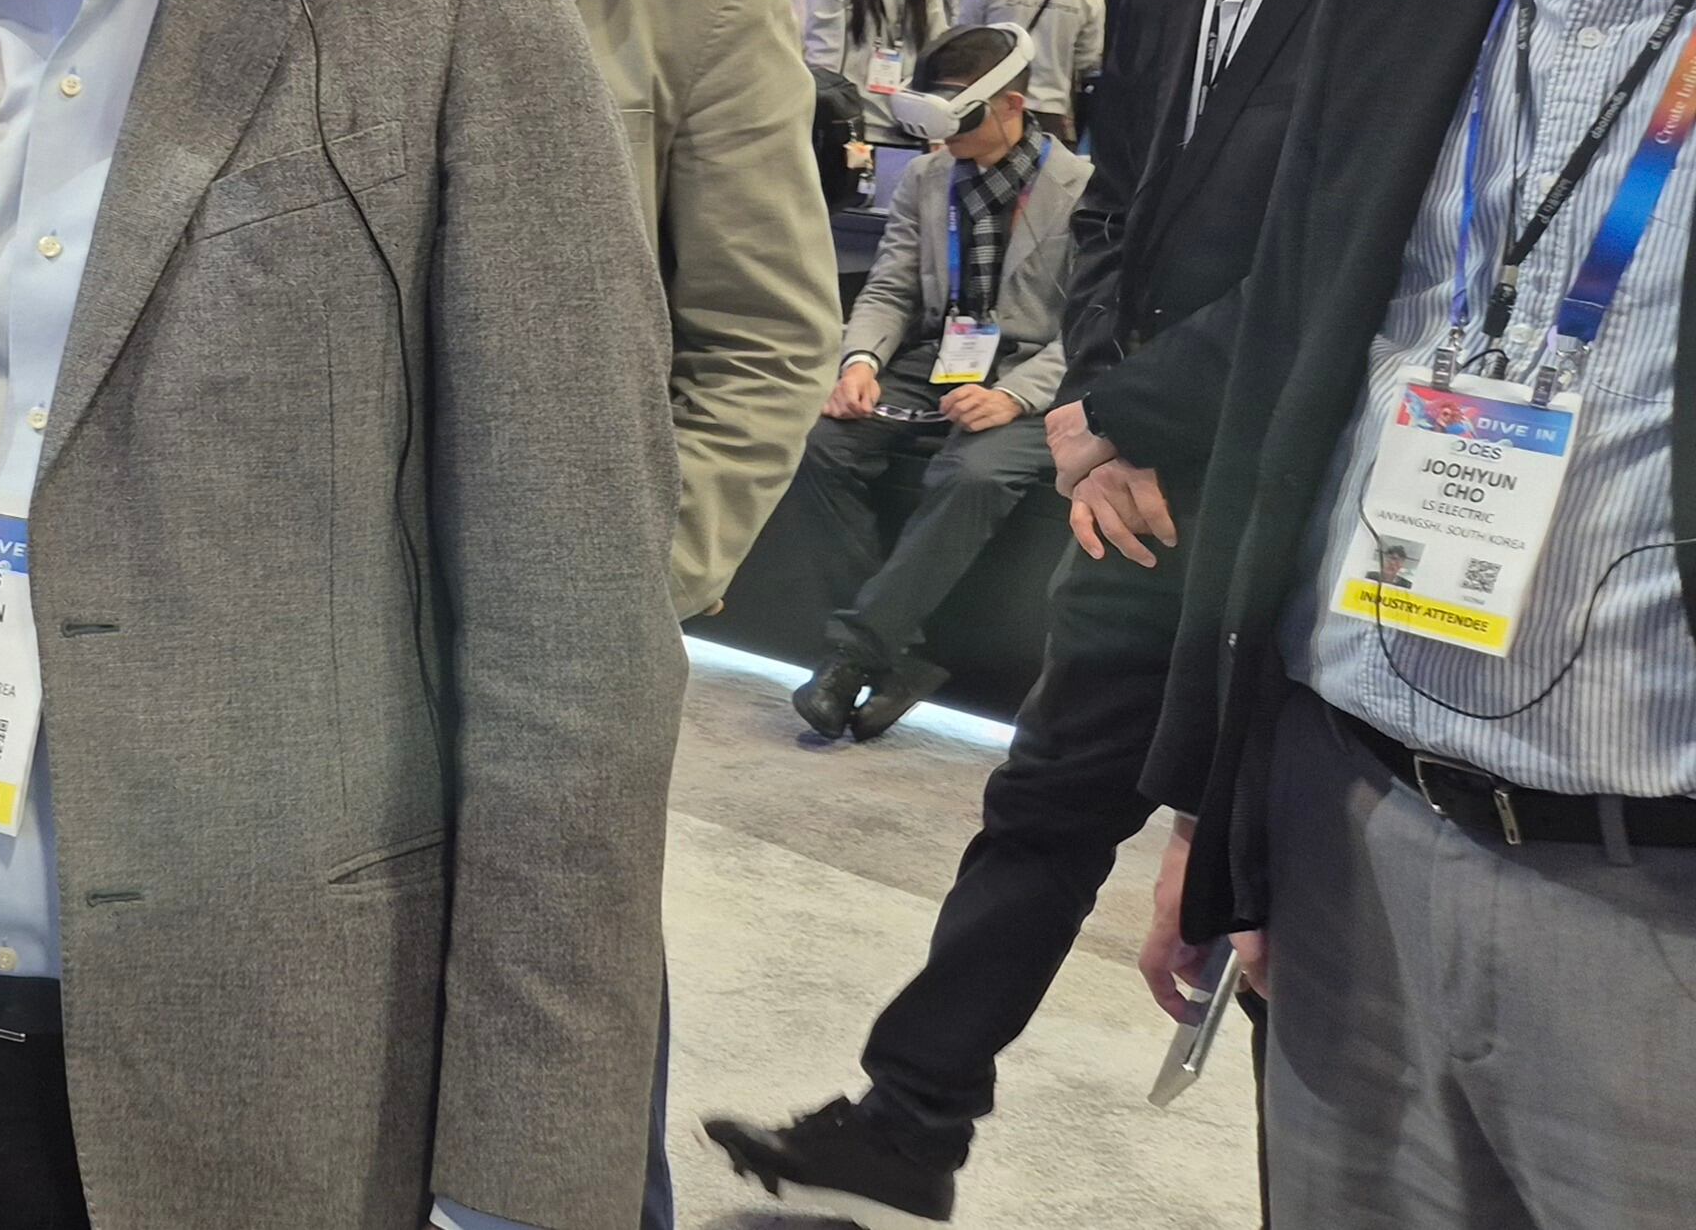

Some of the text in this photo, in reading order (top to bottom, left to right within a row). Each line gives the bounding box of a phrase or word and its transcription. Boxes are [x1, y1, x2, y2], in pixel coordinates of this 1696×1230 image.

[1655, 102, 1686, 144] Create
[1476, 416, 1558, 442] DIVE IN
[1468, 442, 1503, 461] CES
[1421, 457, 1518, 491] JOOHYUN
[1443, 481, 1486, 504] CHO
[1422, 499, 1496, 524] LS ELECTRIC
[1444, 524, 1485, 541] SOUTH
[1488, 532, 1526, 551] KOREA
[1422, 606, 1490, 633] ATTENDEE
